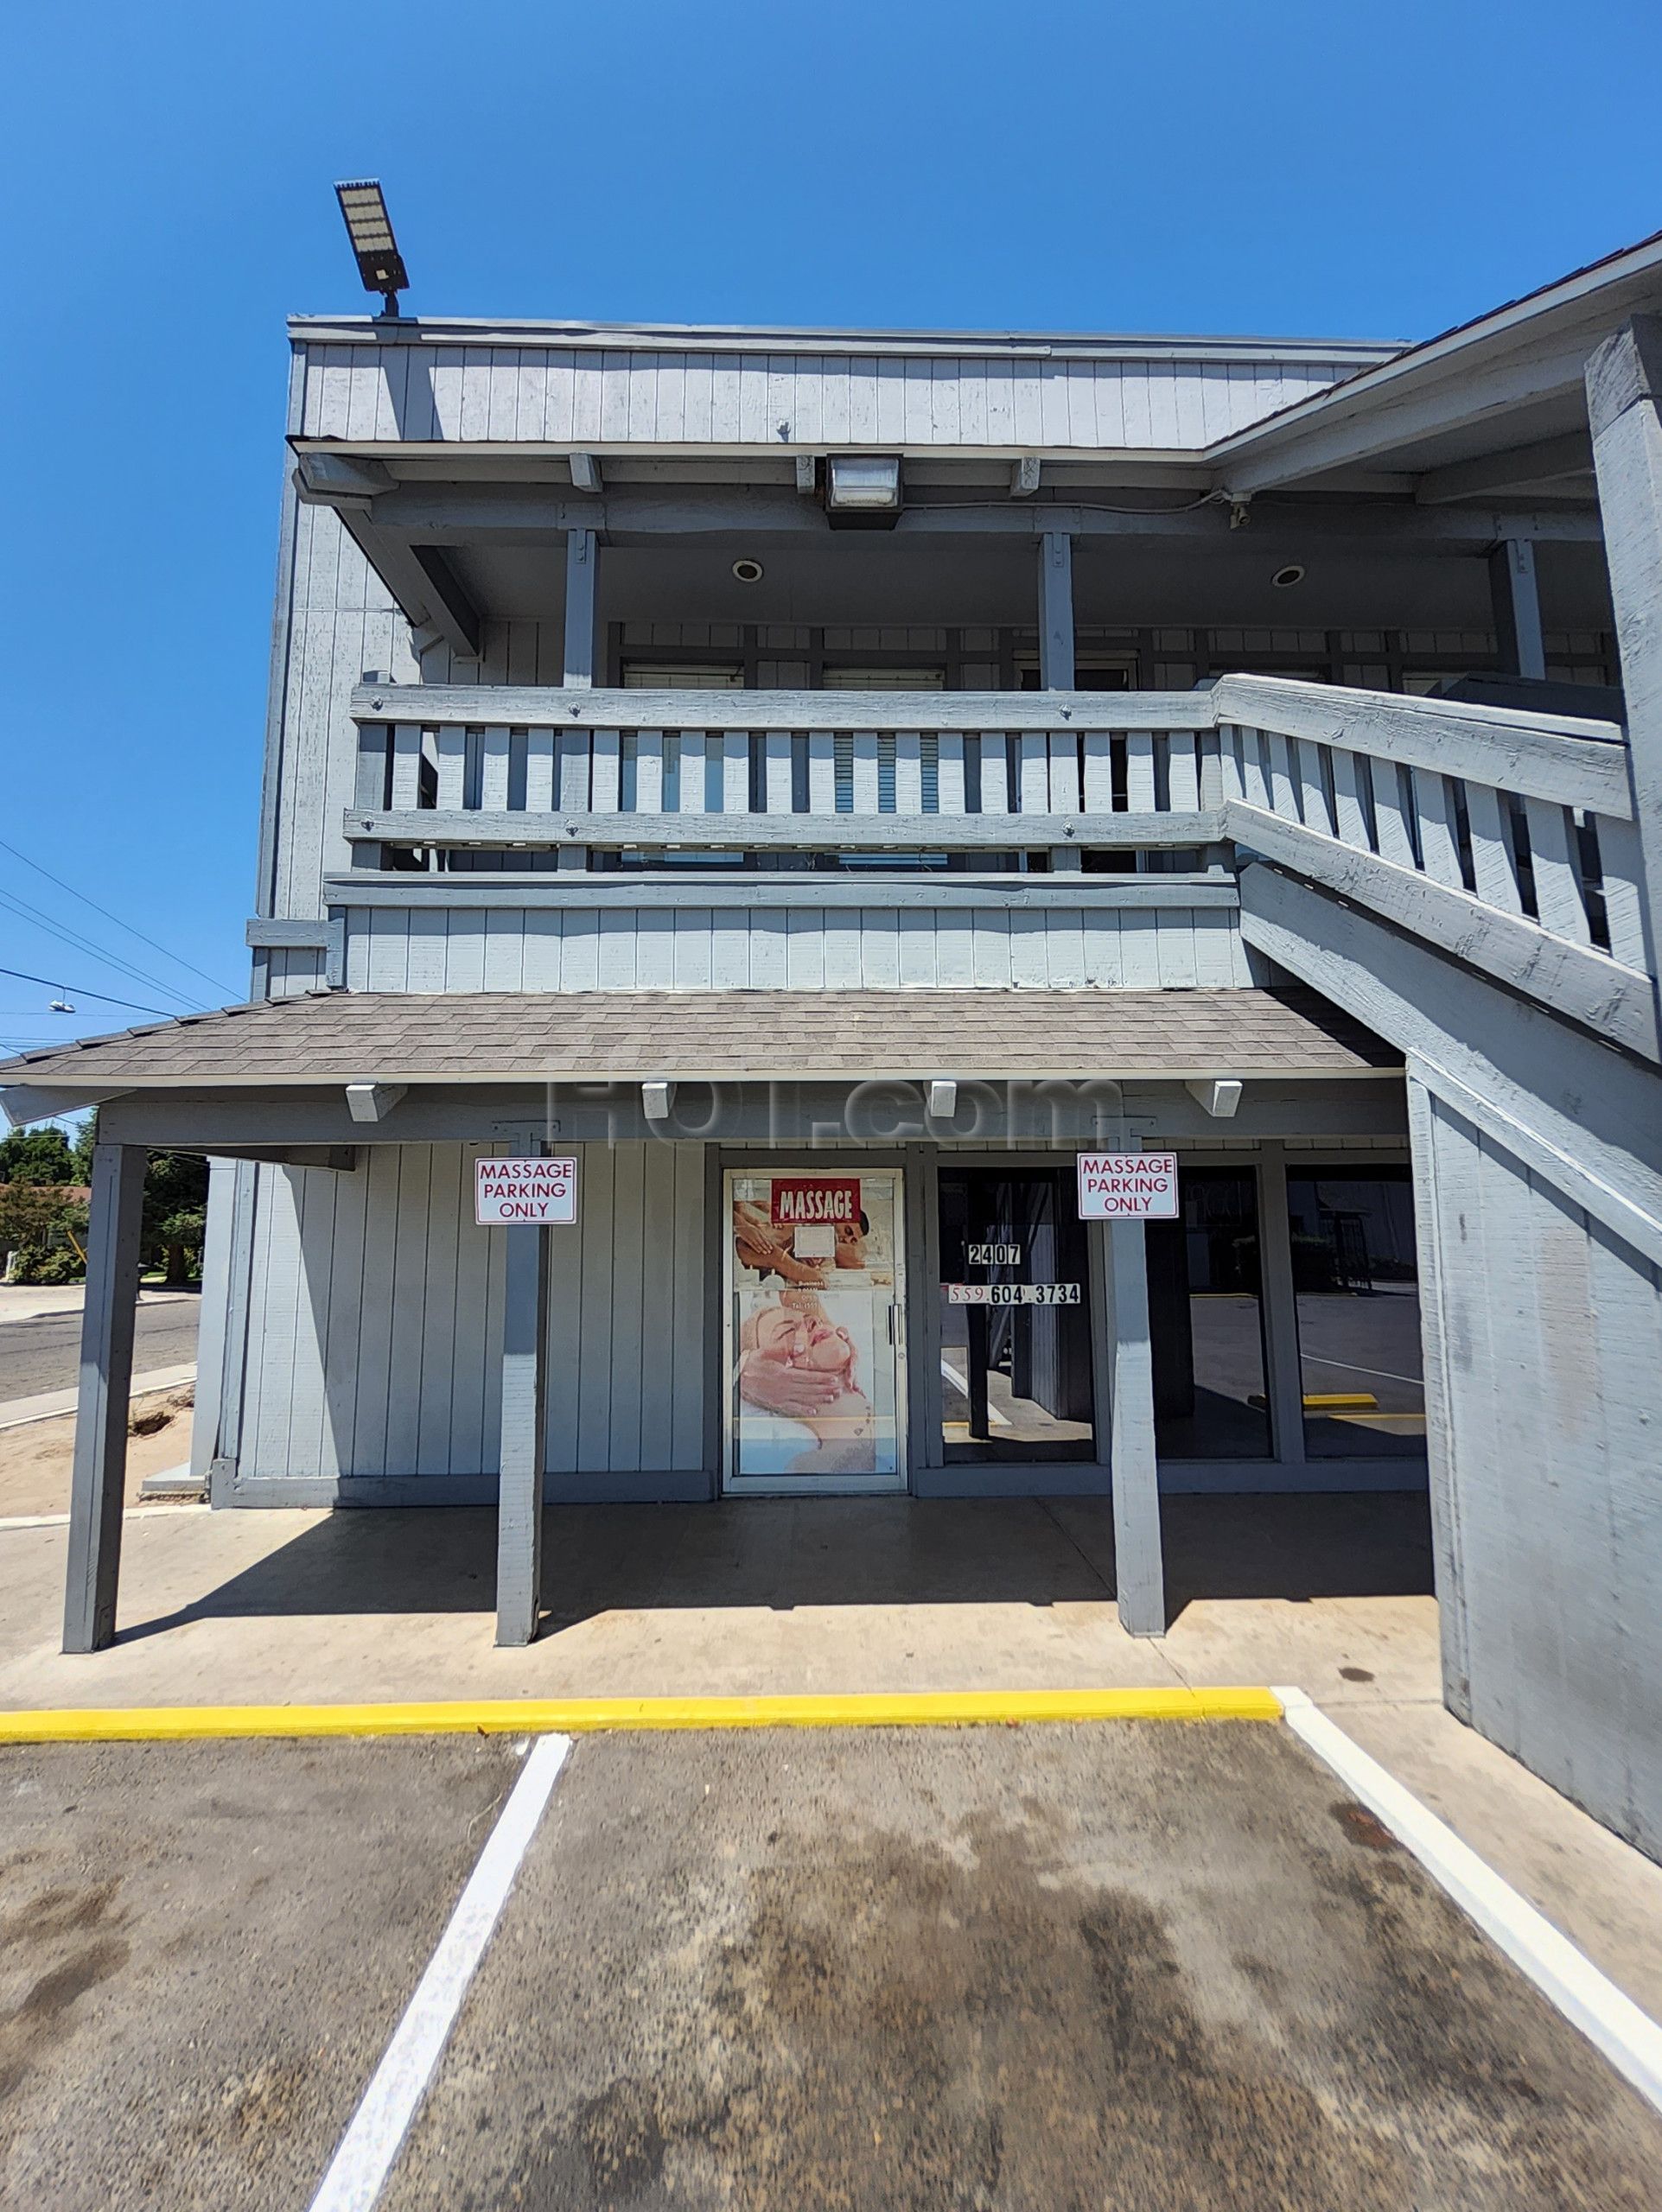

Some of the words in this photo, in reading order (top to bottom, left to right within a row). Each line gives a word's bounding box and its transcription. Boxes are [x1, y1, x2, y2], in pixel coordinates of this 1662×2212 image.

[480, 1164, 572, 1179] MASSAGE
[1083, 1159, 1173, 1174] MASSAGE
[484, 1183, 566, 1198] PARKING
[1087, 1178, 1168, 1192] PARKING
[500, 1203, 549, 1217] ONLY
[780, 1190, 852, 1219] MASSAGE
[1105, 1197, 1152, 1211] ONLY
[970, 1245, 1019, 1263] 2407
